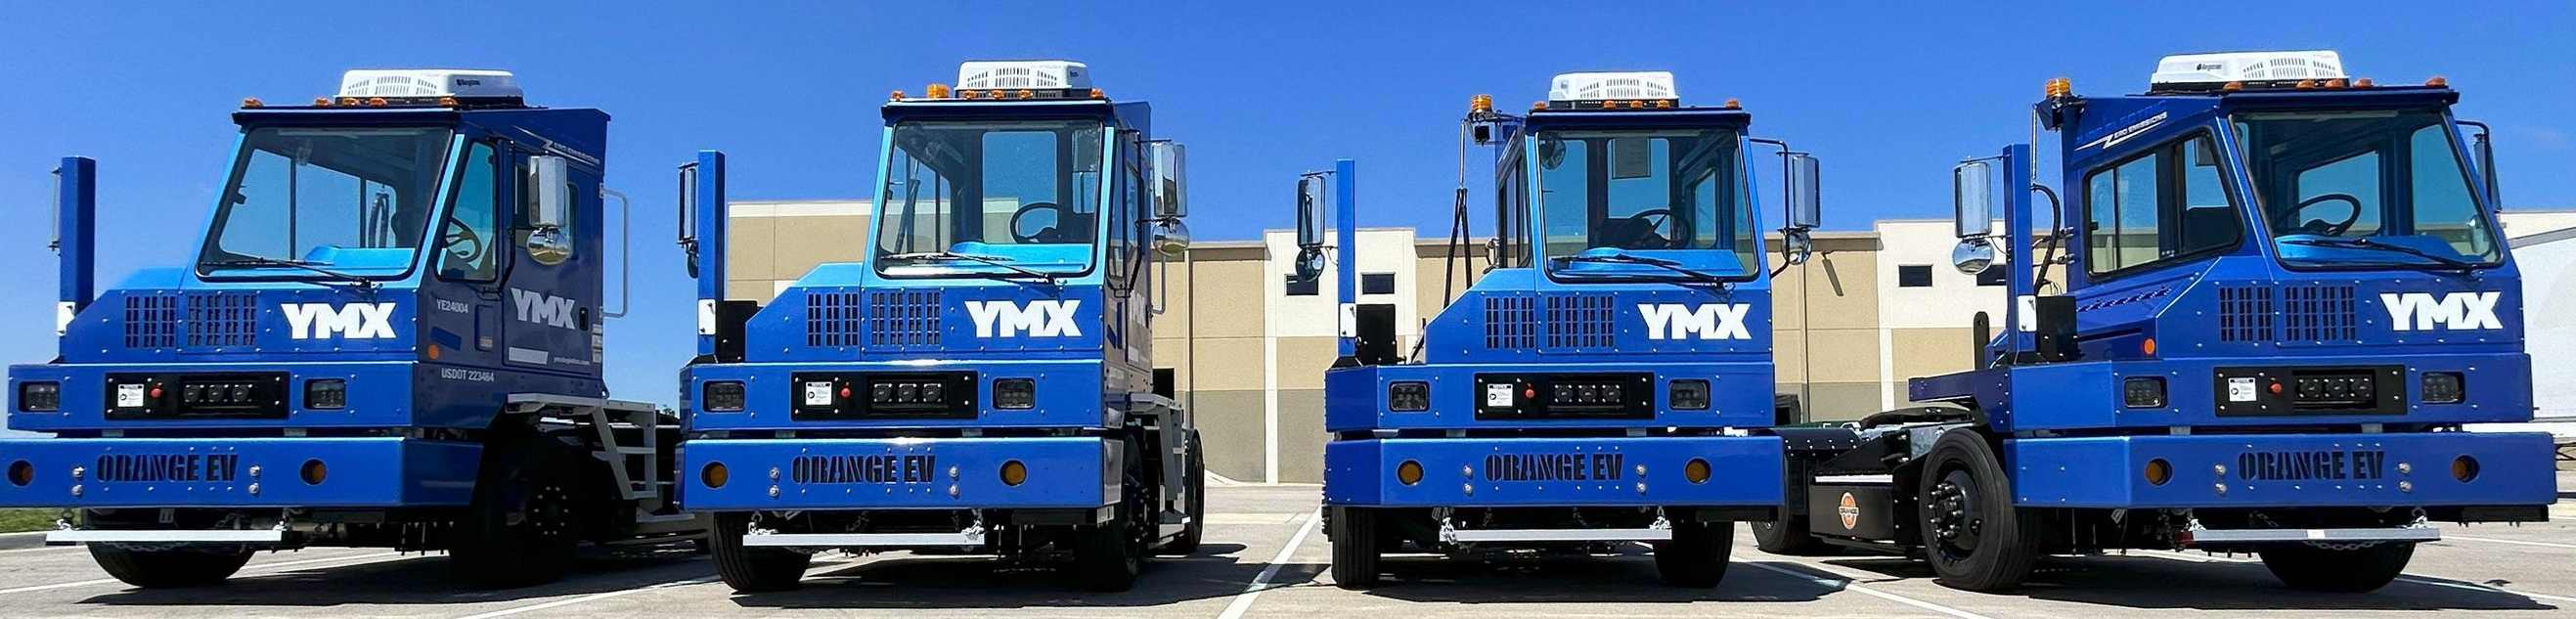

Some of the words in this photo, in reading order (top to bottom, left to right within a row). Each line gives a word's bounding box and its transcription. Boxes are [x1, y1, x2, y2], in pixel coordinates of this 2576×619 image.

[281, 302, 397, 339] YMX
[511, 287, 575, 330] YMX
[964, 299, 1083, 337] YMX
[1637, 303, 1753, 339] YMX
[2379, 291, 2504, 331] YMX
[441, 367, 466, 380] USDOT
[98, 454, 200, 482] ORANGE
[205, 454, 239, 481] EV
[792, 455, 897, 484] ORANGE
[904, 455, 935, 483] EV
[1485, 453, 1586, 482] ORANGE
[1593, 453, 1623, 481] EV
[2238, 451, 2346, 480] ORANGE
[2352, 450, 2384, 479] EV
